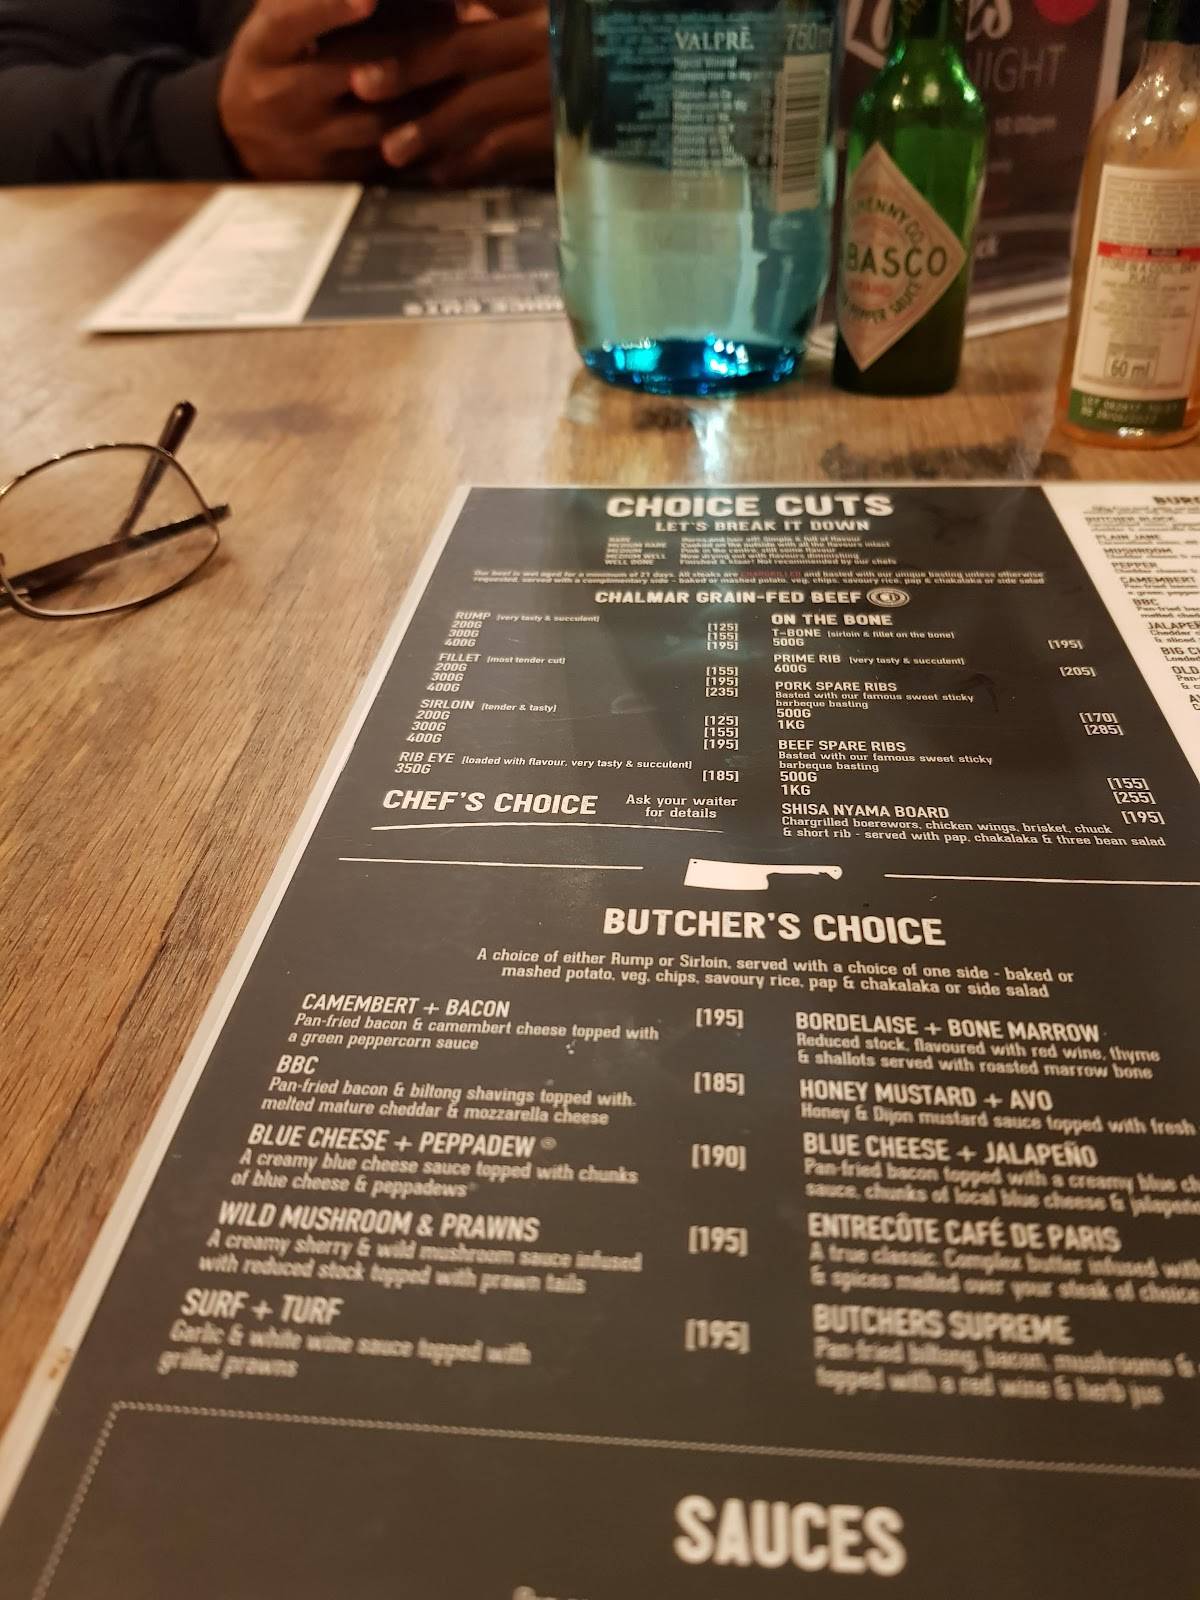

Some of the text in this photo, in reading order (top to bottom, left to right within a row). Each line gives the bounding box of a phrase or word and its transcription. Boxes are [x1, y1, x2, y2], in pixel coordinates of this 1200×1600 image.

[1110, 360, 1128, 378] 60
[606, 494, 893, 518] CHOICE CUTS
[655, 519, 869, 531] LET'S BREAK IT DOWN
[1120, 576, 1196, 584] CAMEMBERT
[594, 590, 689, 603] CHALMAR
[696, 590, 804, 603] GRAIN-FED
[810, 591, 861, 603] BEEF
[454, 611, 491, 620] RUMP
[520, 614, 542, 622] tasty
[771, 613, 892, 625] ON THE BONE
[451, 620, 482, 630] 200G
[707, 622, 738, 632] [125]
[448, 628, 479, 639] 300G
[707, 632, 738, 642] [155]
[771, 628, 820, 638] T-BONE
[444, 638, 476, 646] 400G
[706, 640, 738, 650] [195]
[772, 637, 804, 646] 500G
[1047, 639, 1082, 649] [195]
[438, 652, 481, 662] FILLET
[1160, 647, 1184, 655] BIG
[773, 654, 815, 664] PRIME
[818, 654, 841, 664] RIB
[434, 662, 467, 673] 200G
[706, 666, 738, 678] [155]
[774, 664, 806, 672] 600G
[1059, 666, 1096, 676] [205]
[1171, 665, 1200, 674] OLD
[431, 672, 464, 683] 300G
[705, 676, 738, 688] [195]
[426, 682, 460, 692] 400G
[705, 686, 738, 697] [235]
[775, 681, 897, 692] PORK SPARE RIBS
[419, 698, 474, 710] SIRLOIN
[415, 709, 450, 720] 200G
[776, 708, 810, 718] 500G
[1078, 712, 1119, 724] [170]
[411, 720, 446, 731] 300G
[704, 715, 738, 728] [125]
[777, 719, 804, 729] 1KG
[704, 726, 738, 738] [155]
[1084, 724, 1123, 735] [285]
[406, 732, 442, 743] 400G
[703, 738, 738, 750] [195]
[778, 739, 906, 752] BEEF SPARE RIBS
[397, 751, 424, 762] RIB
[427, 752, 456, 764] EYE
[503, 756, 525, 765] with
[571, 760, 594, 768] very
[597, 759, 622, 769] tasty
[394, 762, 431, 773] 350G
[702, 769, 738, 782] [185]
[780, 770, 817, 782] 500G
[780, 784, 810, 795] 1KG
[1106, 778, 1150, 790] [155]
[382, 789, 598, 814] CHEF'S CHOICE
[625, 794, 738, 809] Ask your waiter
[1112, 791, 1156, 804] [255]
[644, 806, 717, 818] for details
[781, 803, 950, 818] SHISA NYAMA BOARD
[1120, 810, 1165, 824] [195]
[603, 907, 946, 945] BUTCHER'S CHOICE
[301, 994, 510, 1018] CAMEMBERT + BACON
[696, 1007, 743, 1028] [195]
[796, 1012, 1098, 1042] BORDELAISE + BONE MARROW
[276, 1054, 318, 1074] BBC
[694, 1071, 744, 1095] [185]
[800, 1078, 1052, 1110] HONEY MUSTARD + AVO
[248, 1123, 536, 1158] BLUE CHEESE + PEPPADEW
[803, 1132, 1097, 1168] BLUE CHEESE + JALAPEÑO
[692, 1143, 745, 1170] [190]
[218, 1200, 539, 1242] WILD MUSHROOM & PRAWNS
[808, 1212, 1122, 1253] ENTRECÔTE CAFÉ DE PARIS
[688, 1225, 747, 1256] [195]
[181, 1287, 343, 1324] SURF + TURF
[812, 1303, 1072, 1344] BUTCHERS SUPREME
[685, 1318, 748, 1354] [195]
[674, 1495, 904, 1575] SAUCES
